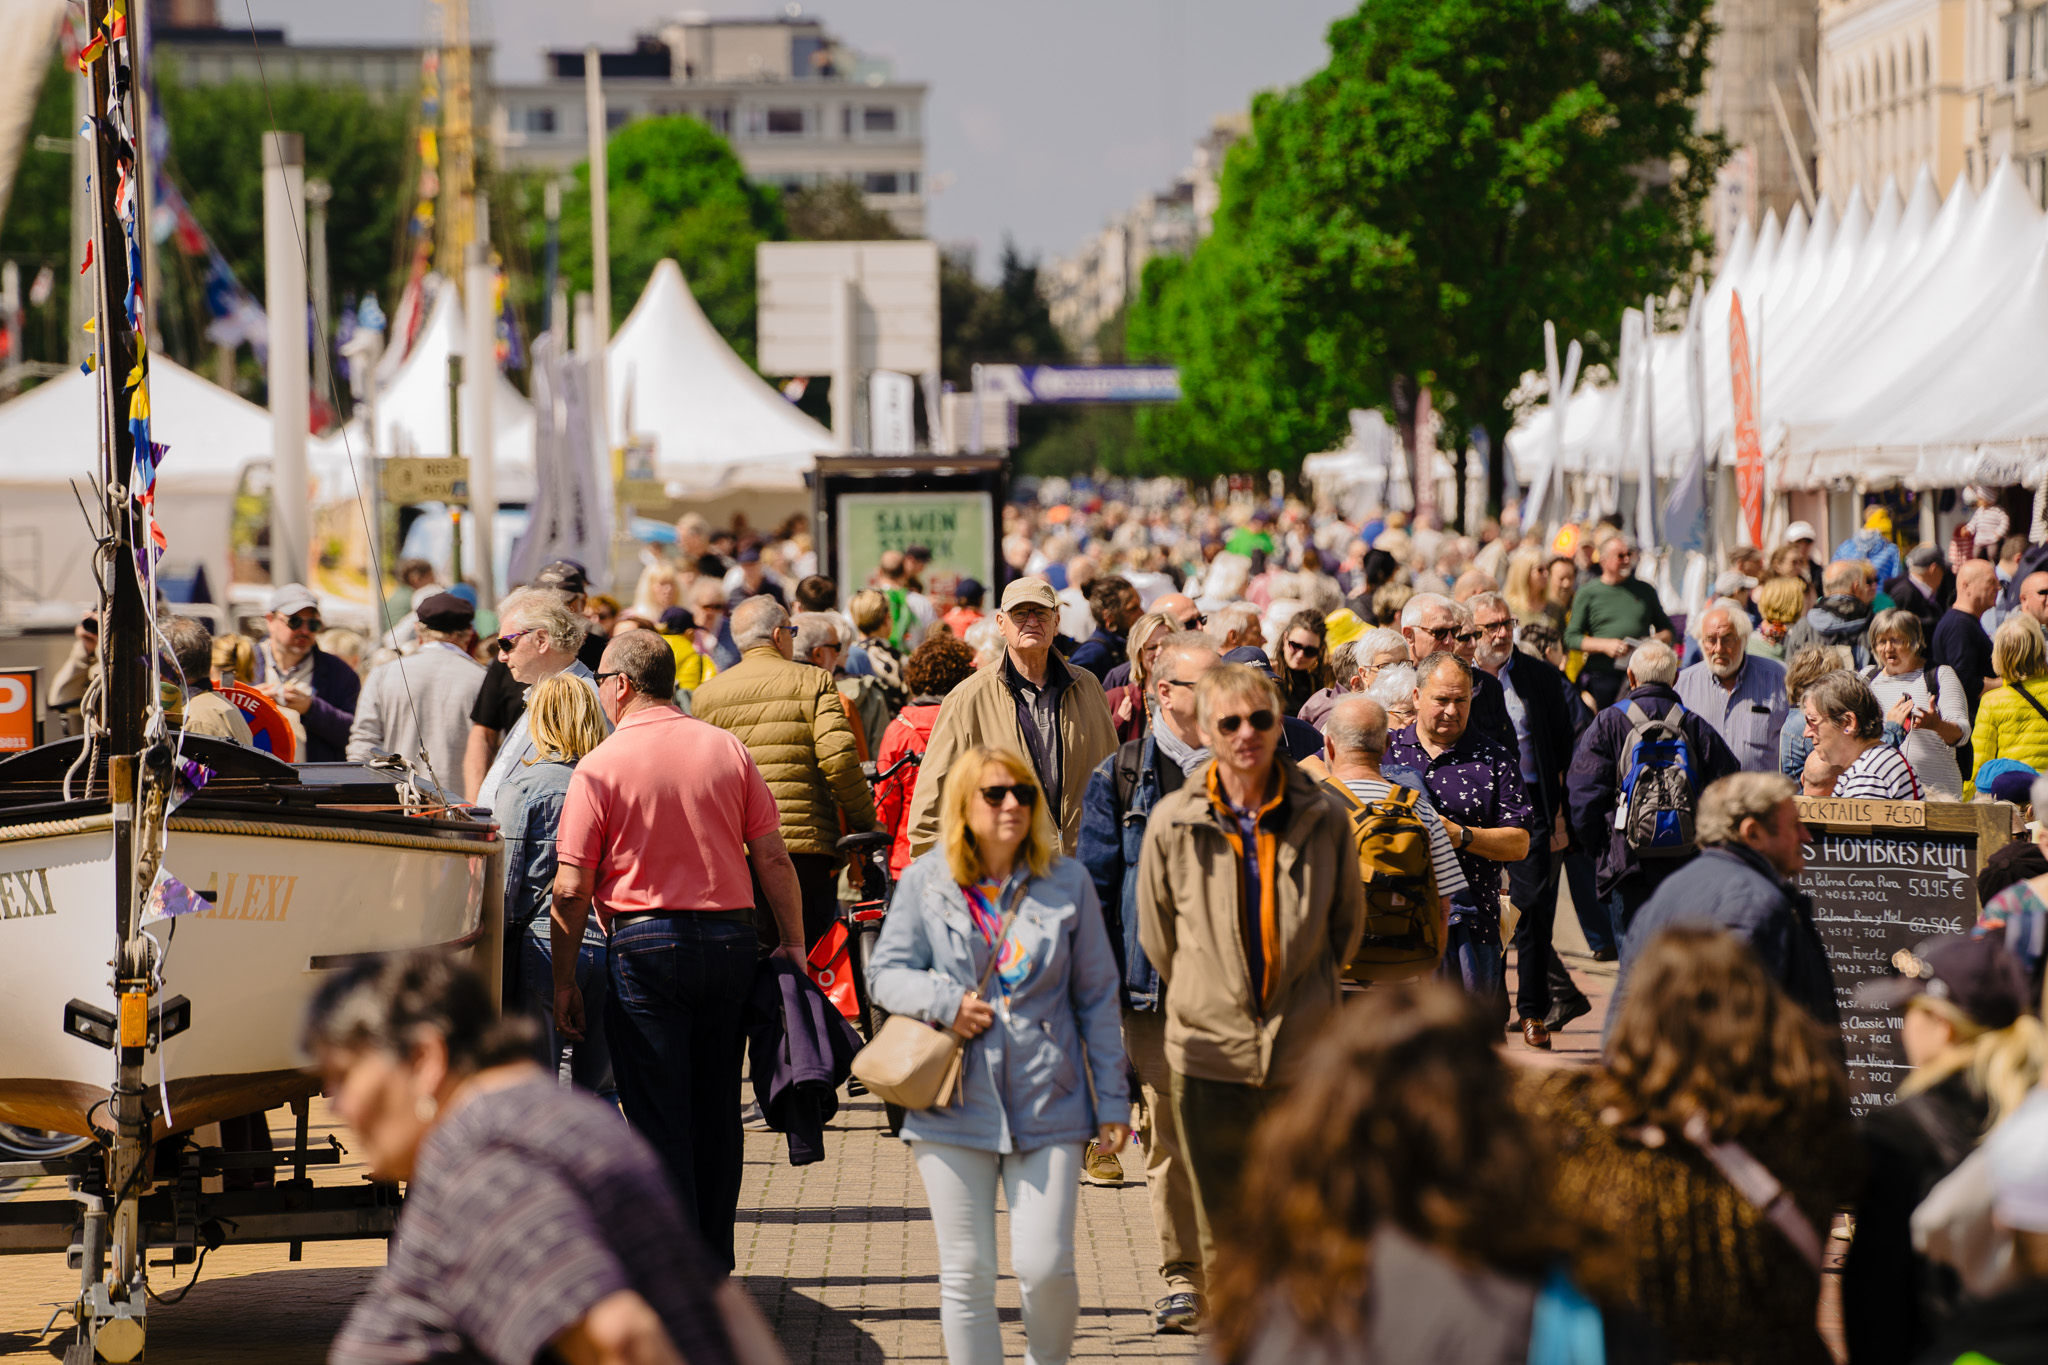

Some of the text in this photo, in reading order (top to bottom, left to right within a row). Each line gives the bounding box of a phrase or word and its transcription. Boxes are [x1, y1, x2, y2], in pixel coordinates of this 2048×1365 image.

[1823, 836, 1919, 865] HOMBRES
[1922, 841, 1967, 869] RUM
[1799, 873, 1815, 886] La
[1815, 872, 1846, 887] Palma
[0, 867, 57, 920] EXI
[1852, 945, 1889, 961] Fuerte
[1849, 1015, 1887, 1030] Classic
